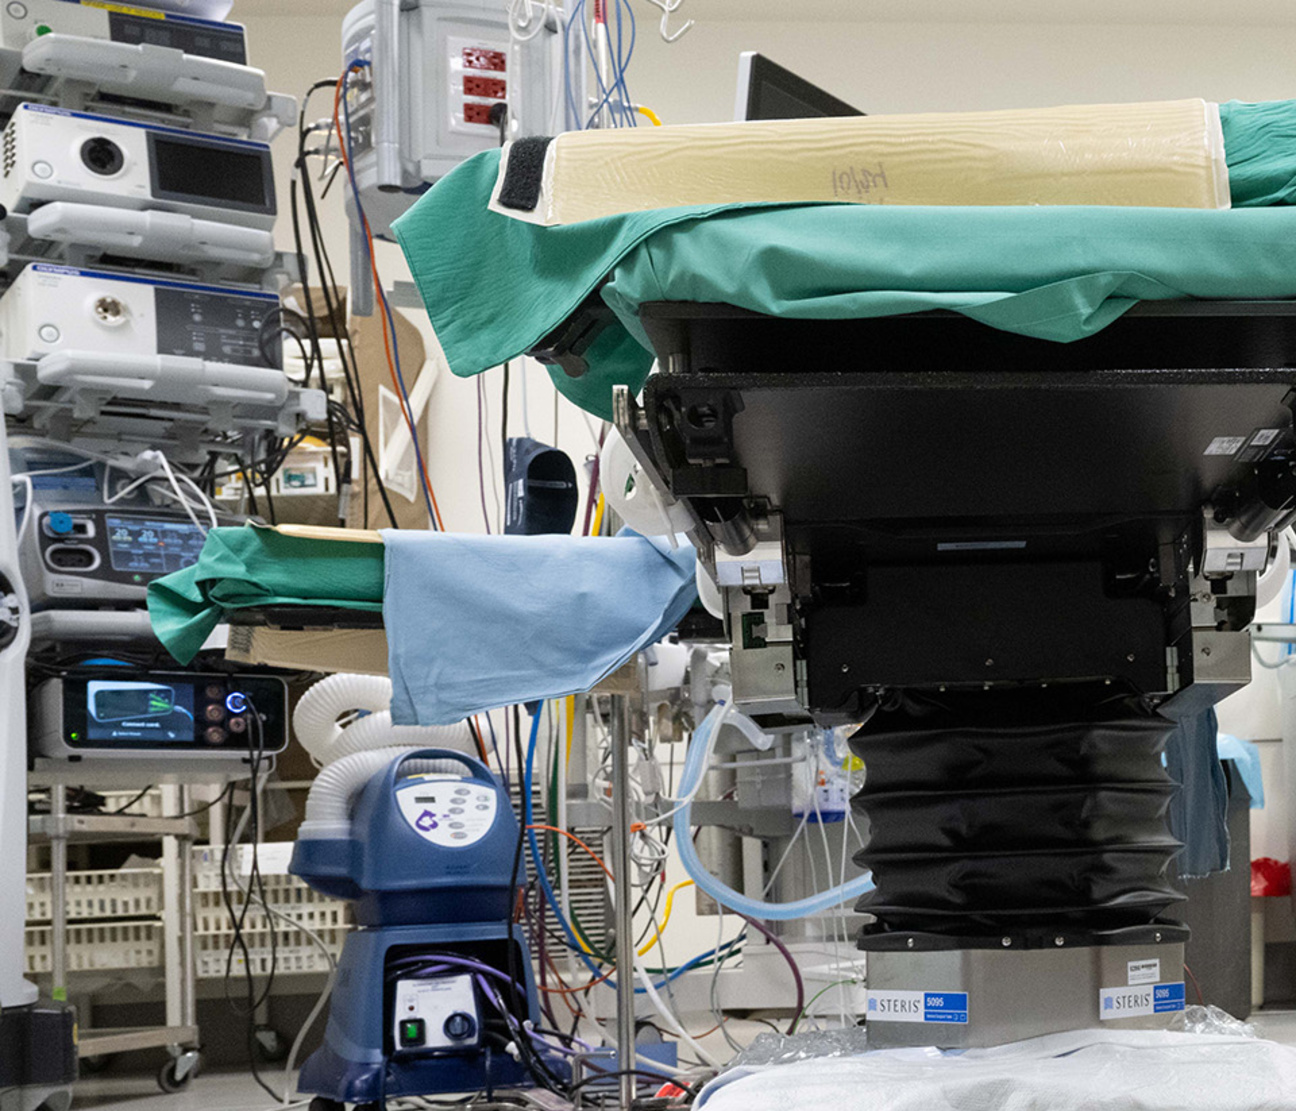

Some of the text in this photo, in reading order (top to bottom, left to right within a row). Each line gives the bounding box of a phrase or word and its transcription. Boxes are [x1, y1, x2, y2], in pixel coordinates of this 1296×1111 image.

[114, 528, 156, 538] 20 20
[880, 999, 919, 1013] STERIS
[926, 997, 944, 1007] 5095
[1115, 994, 1150, 1010] STERIS
